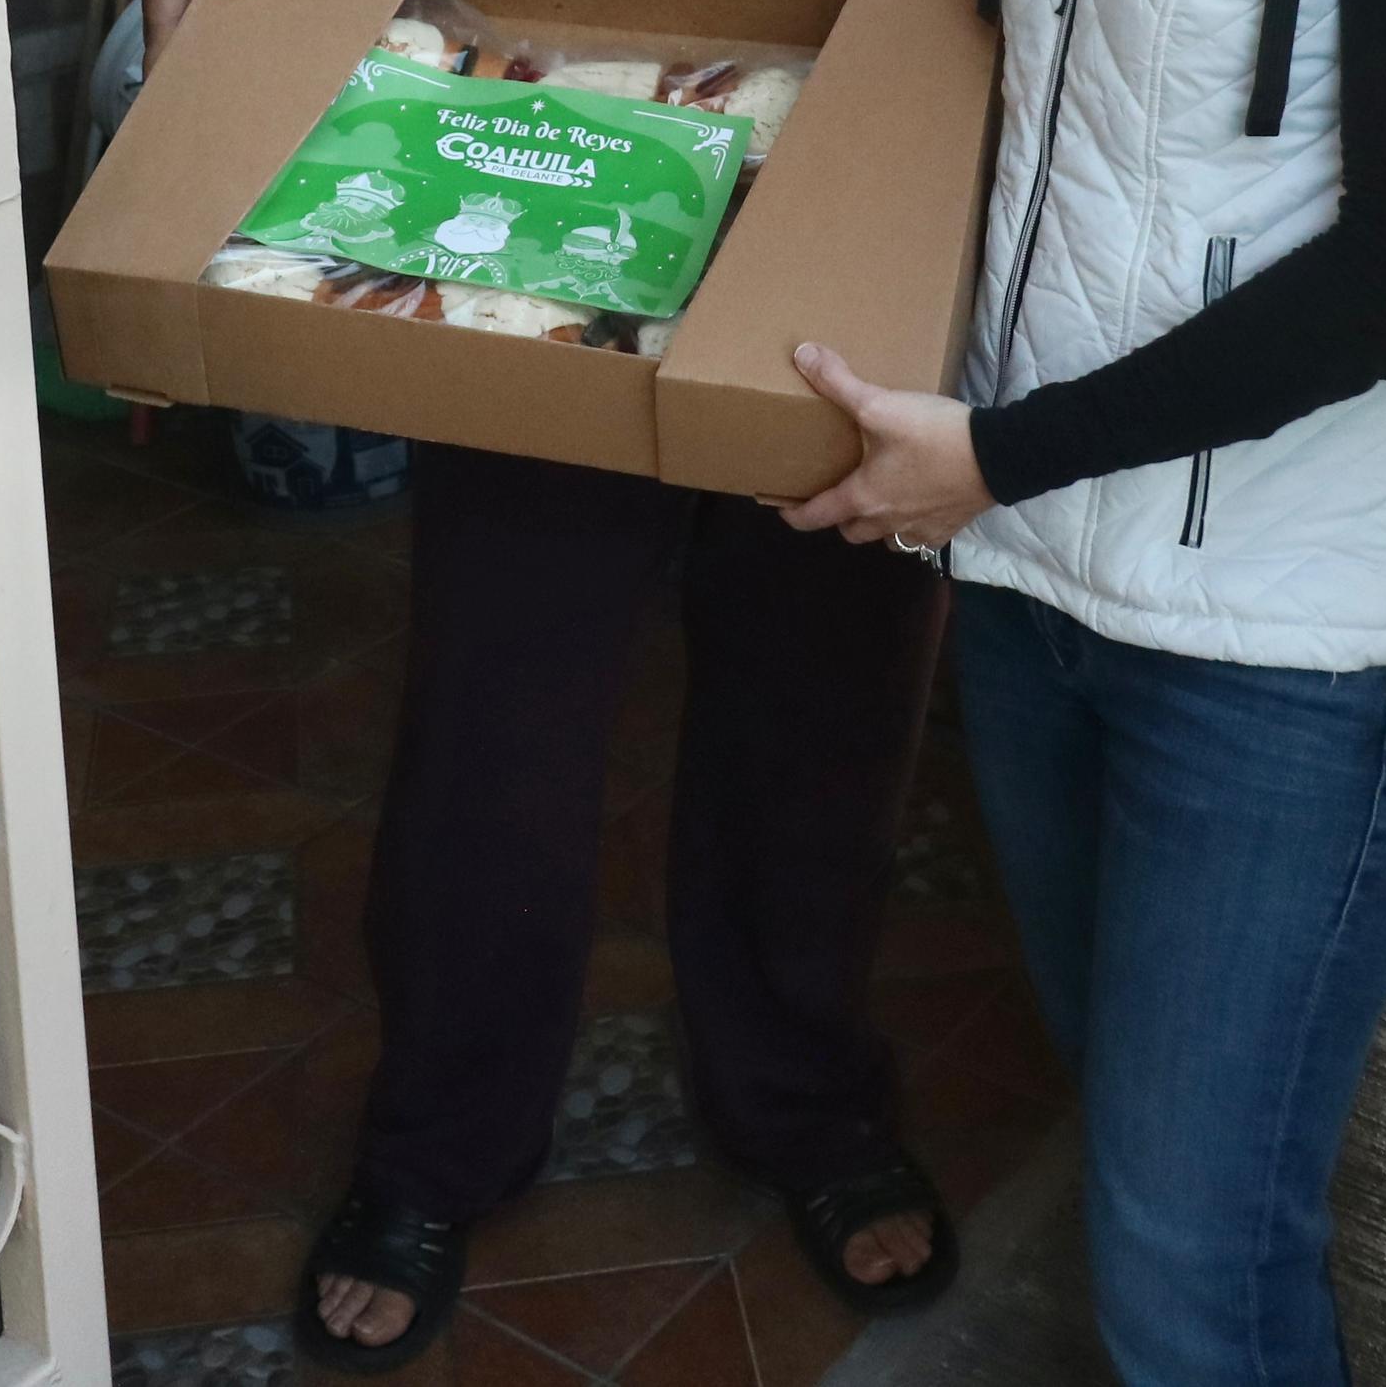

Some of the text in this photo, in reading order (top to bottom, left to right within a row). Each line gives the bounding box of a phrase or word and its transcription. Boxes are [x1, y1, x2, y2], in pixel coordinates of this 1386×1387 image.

[437, 109, 488, 132] Feliz
[535, 121, 561, 141] de
[567, 126, 633, 153] Reyes
[436, 132, 596, 178] COAHUILA
[511, 169, 564, 183] DELANTE
